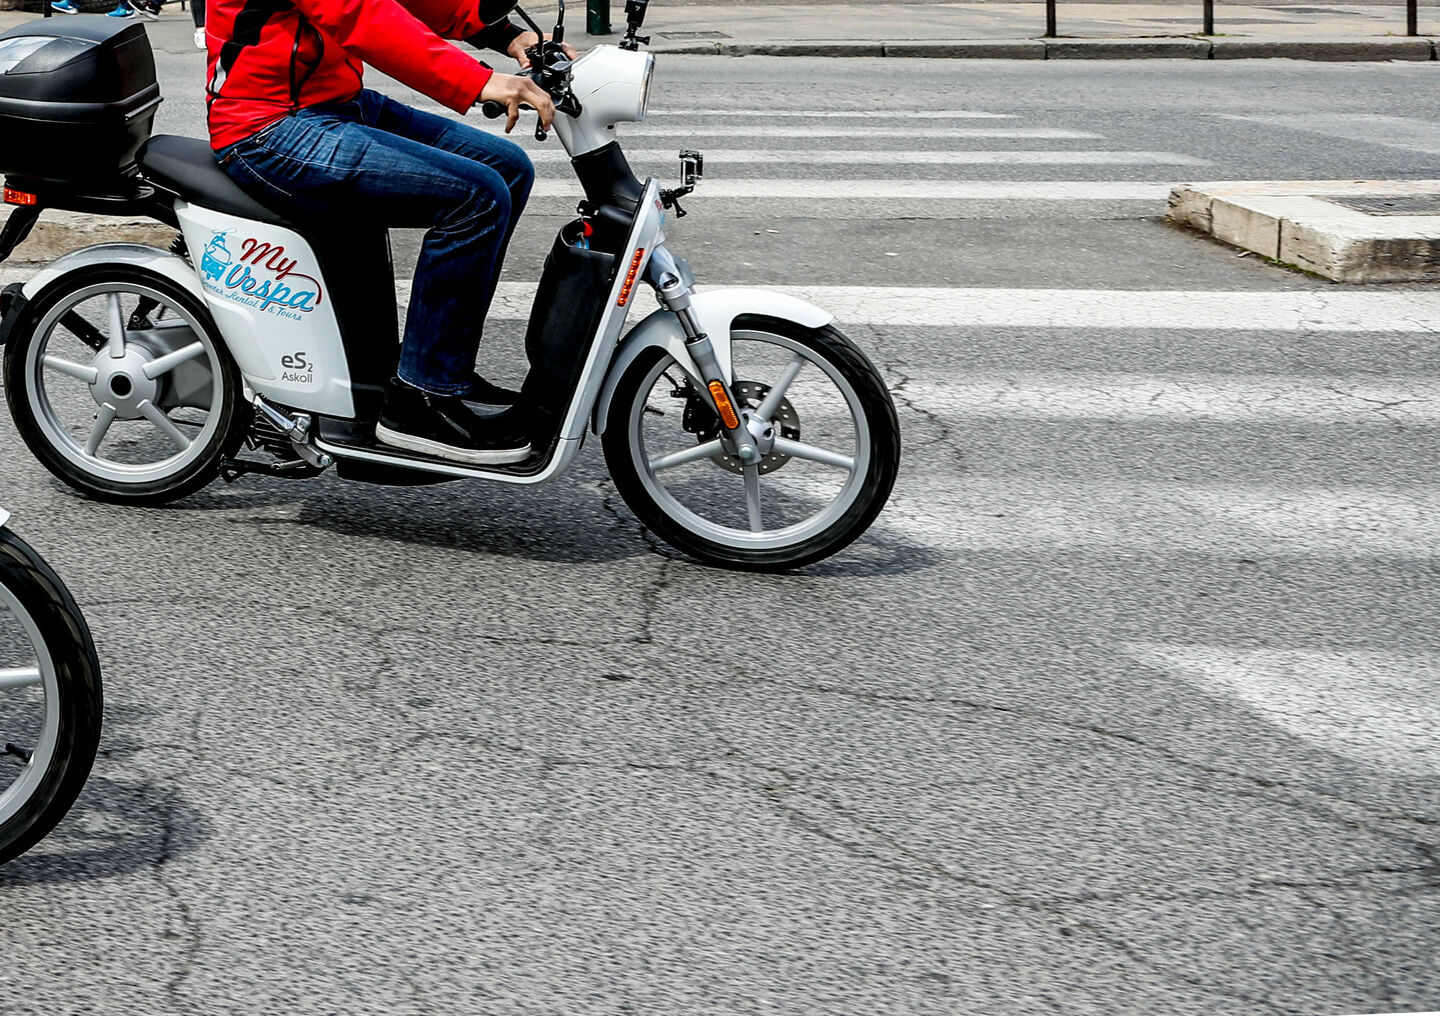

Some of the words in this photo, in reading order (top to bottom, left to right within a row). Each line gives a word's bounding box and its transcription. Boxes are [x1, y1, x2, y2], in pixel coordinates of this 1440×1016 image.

[225, 264, 316, 313] Vespa
[225, 291, 259, 308] Rental
[276, 306, 302, 321] Tours
[281, 371, 313, 384] Askoll
